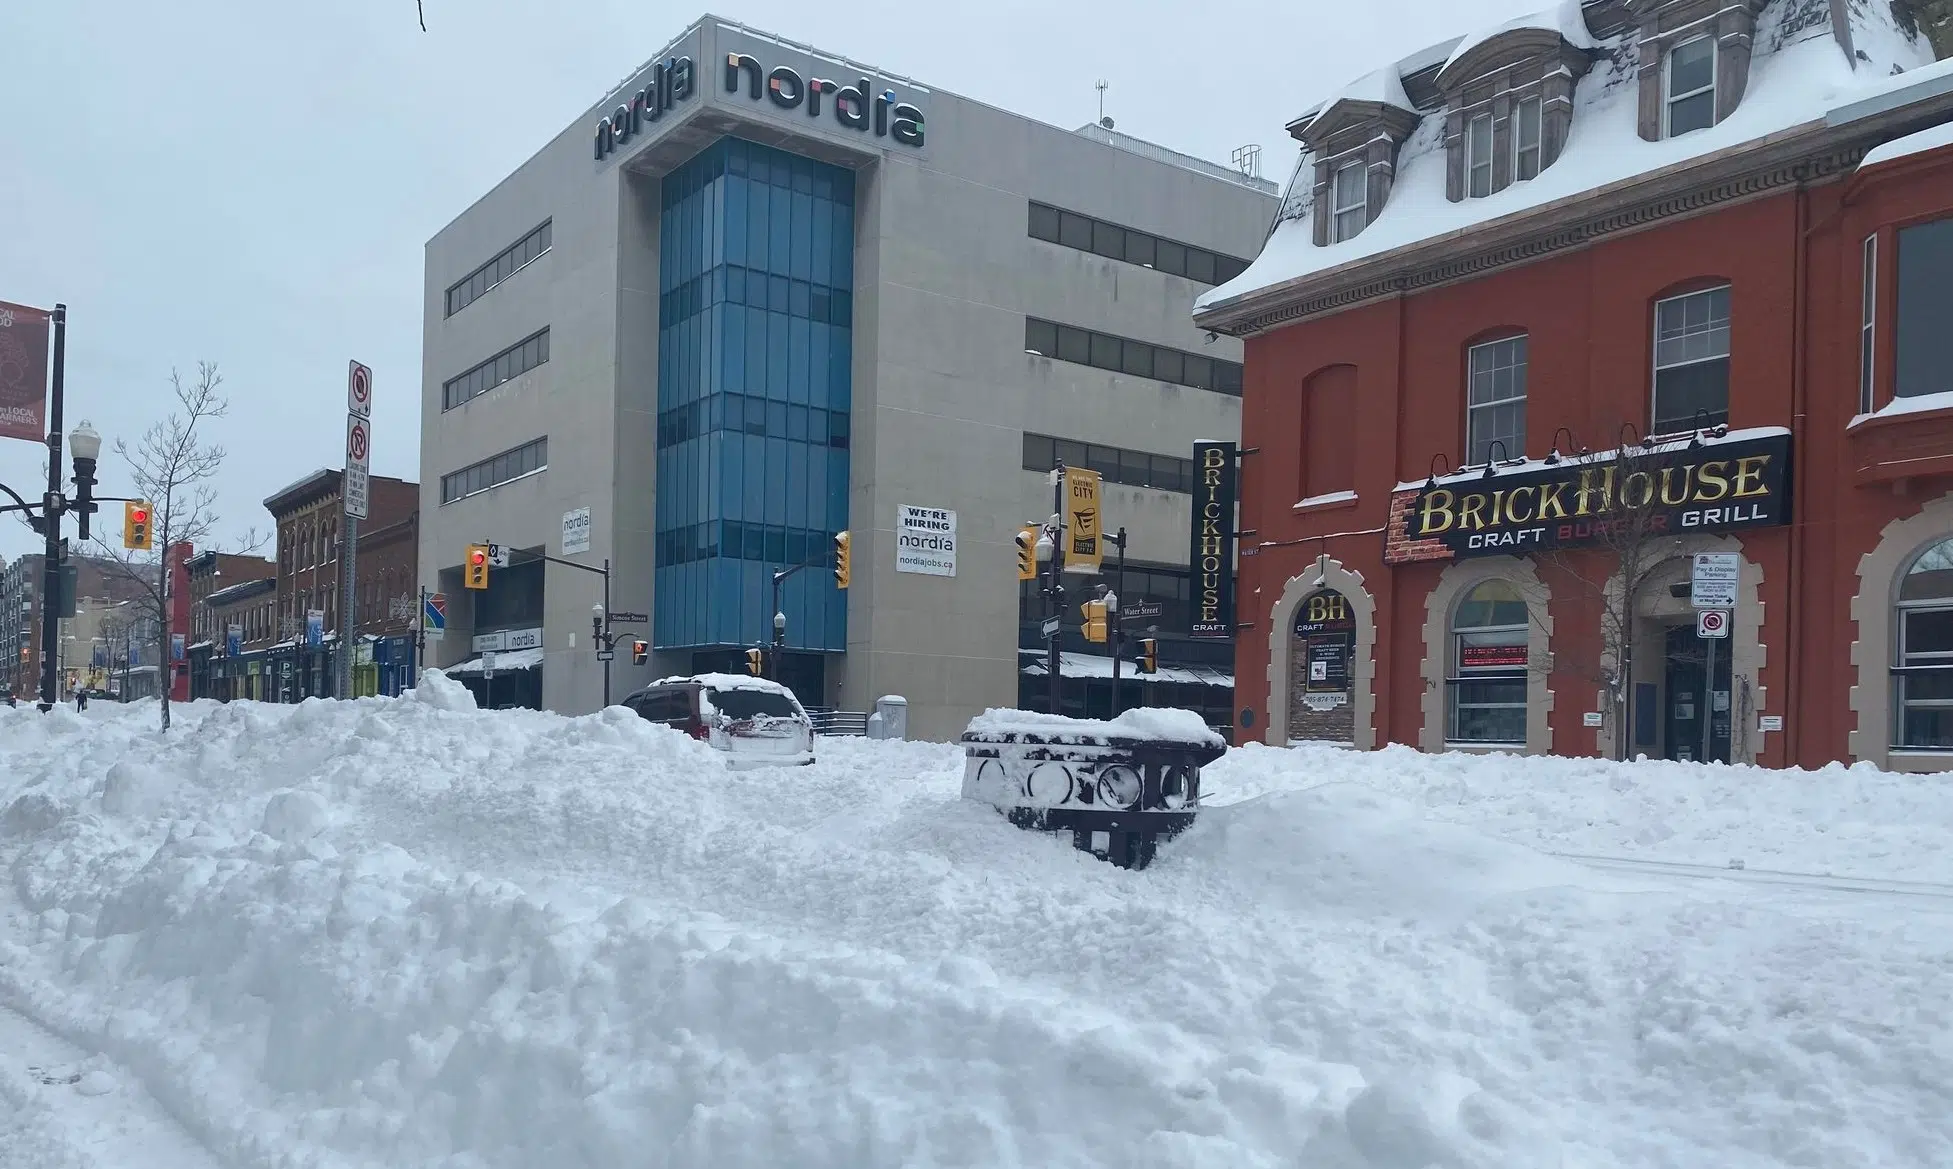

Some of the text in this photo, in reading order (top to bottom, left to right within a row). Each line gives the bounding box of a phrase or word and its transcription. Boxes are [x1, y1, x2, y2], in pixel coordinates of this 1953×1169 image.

[726, 52, 925, 147] nordia
[594, 55, 694, 160] nordia
[8, 406, 34, 417] LOCAL
[1074, 486, 1093, 499] CITY
[908, 508, 947, 519] WE'RE
[564, 513, 589, 531] nordia
[904, 518, 950, 530] HIRING
[1468, 528, 1546, 549] CRAFT
[1681, 503, 1768, 528] GRILL
[1201, 448, 1225, 622] BRICKHOUSE
[900, 535, 953, 551] nordia
[900, 557, 953, 568] nordiajobs.ca
[1124, 607, 1140, 616] Water
[1308, 594, 1345, 622] BH
[1296, 623, 1325, 632] CRAFT
[511, 633, 535, 647] nordia
